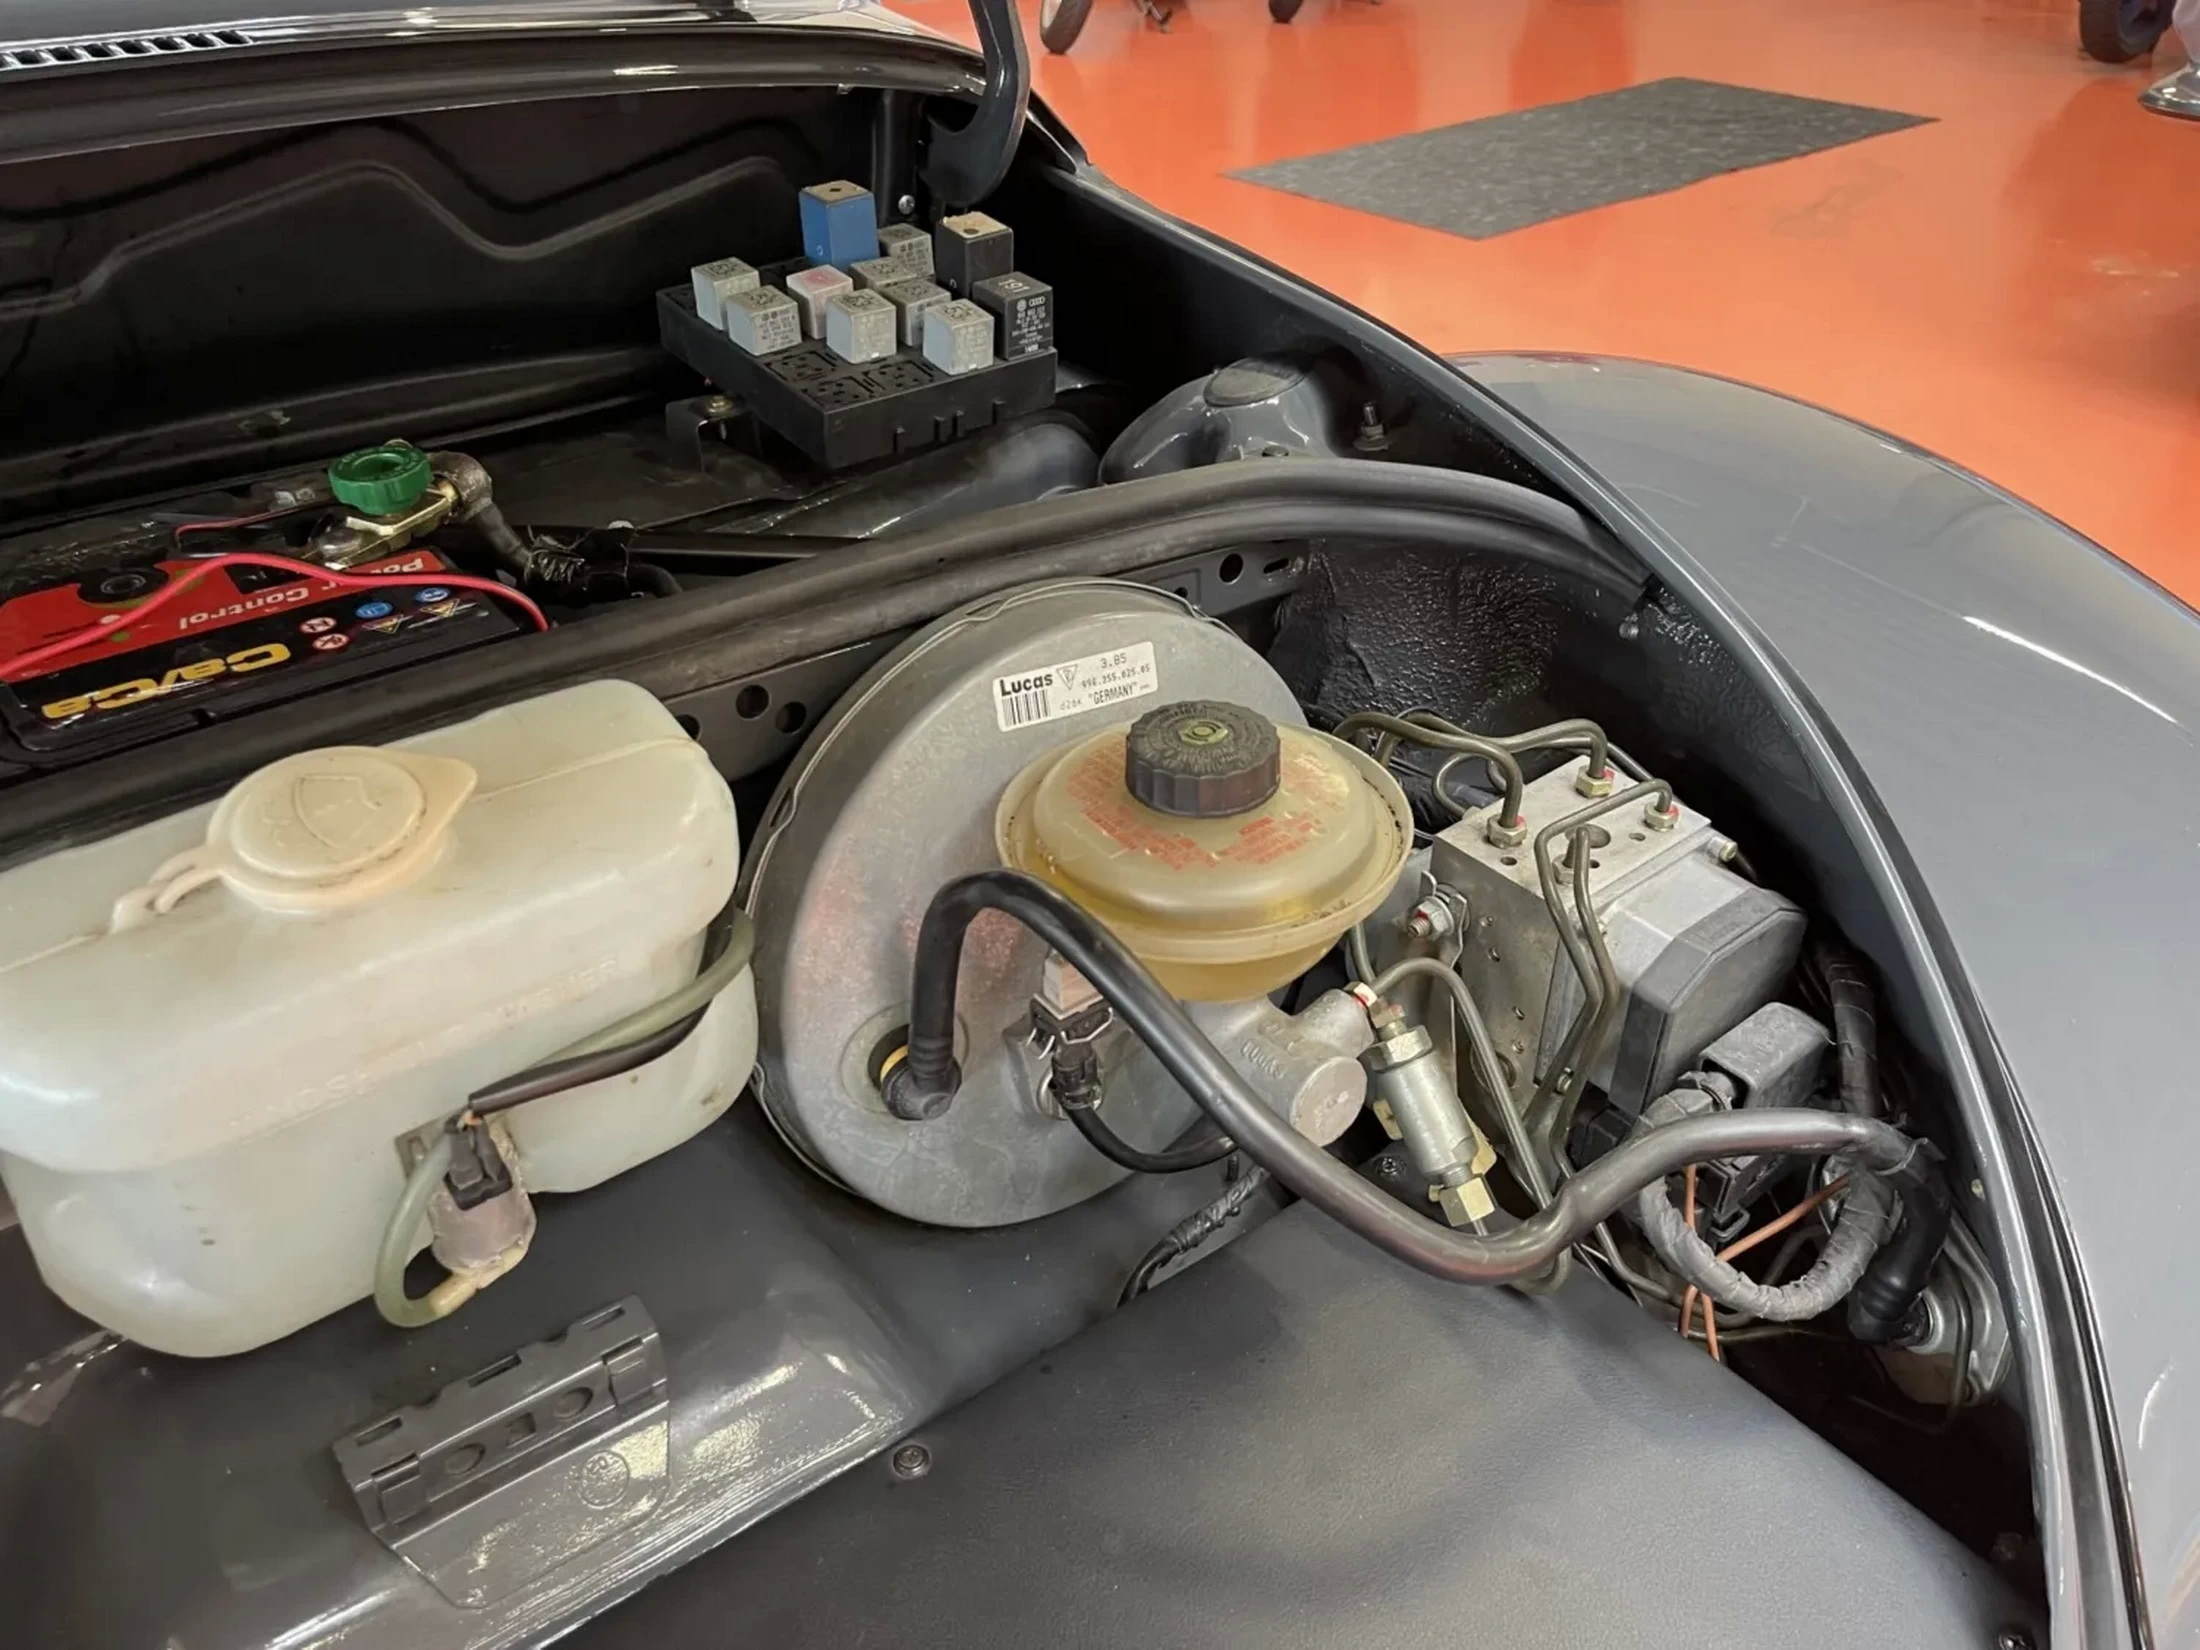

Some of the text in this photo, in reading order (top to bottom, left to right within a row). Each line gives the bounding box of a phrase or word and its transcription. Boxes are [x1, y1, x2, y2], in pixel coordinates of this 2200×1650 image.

[178, 557, 424, 629] Por Control
[41, 642, 292, 720] Ca/Ca
[1000, 673, 1053, 697] Lucas
